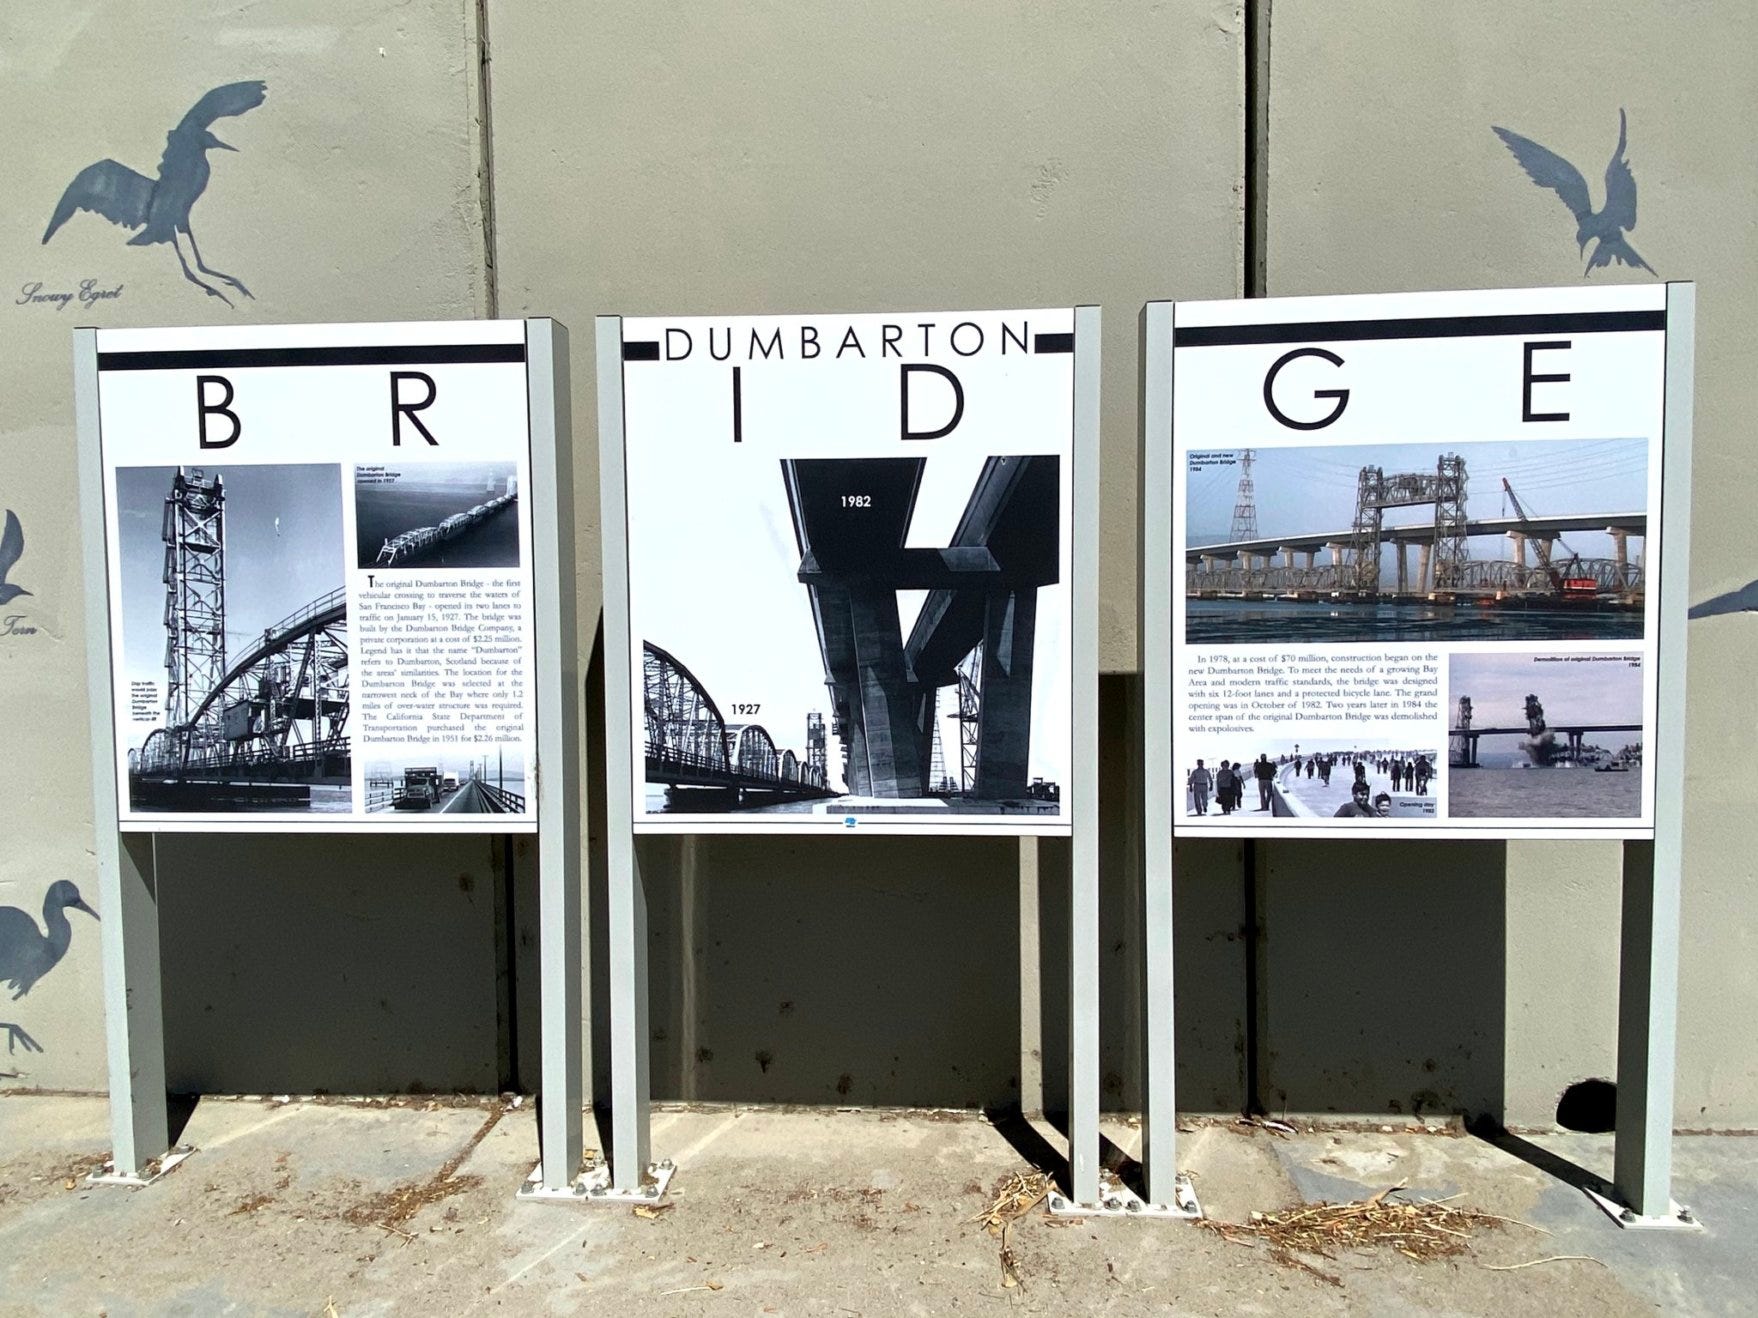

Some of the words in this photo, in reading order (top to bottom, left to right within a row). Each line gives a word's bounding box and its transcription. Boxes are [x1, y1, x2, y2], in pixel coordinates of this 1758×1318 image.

[16, 282, 74, 311] Snowy
[79, 279, 124, 309] Egret
[666, 321, 1028, 361] DUMBARTON
[1263, 347, 1350, 430] G
[1522, 341, 1572, 422] E
[732, 366, 742, 442] I
[900, 364, 964, 440] D
[196, 376, 241, 450] B
[390, 372, 438, 447] R
[841, 495, 871, 508] 1982
[368, 575, 383, 588] The
[385, 579, 412, 589] original
[415, 579, 457, 587] Dumbarton
[460, 579, 483, 589] Bridge
[492, 579, 503, 587] the
[506, 579, 520, 587] first
[358, 591, 390, 599] vehicular
[394, 591, 423, 600] crossing
[438, 590, 466, 598] traverse
[469, 590, 480, 598] the
[485, 590, 507, 598] waters
[359, 613, 380, 621] traffic
[397, 613, 423, 623] January
[465, 613, 478, 621] The
[481, 613, 504, 622] bridge
[359, 624, 375, 632] built
[379, 624, 387, 634] by
[390, 624, 401, 632] the
[405, 624, 448, 632] Dumbarton
[451, 624, 474, 633] Bridge
[359, 635, 383, 645] private
[386, 635, 428, 645] corporation
[444, 635, 459, 643] cost
[473, 635, 492, 643] $2.25
[1197, 655, 1206, 663] In
[1232, 655, 1239, 663] at
[1249, 655, 1265, 663] cost
[1268, 654, 1278, 662] of
[1281, 654, 1295, 662] $70
[1330, 654, 1381, 662] construction
[1384, 654, 1408, 664] began
[1424, 654, 1438, 662] the
[1207, 666, 1253, 674] Dumbarton
[1287, 666, 1299, 674] To
[1301, 666, 1321, 674] meet
[1324, 666, 1336, 674] the
[1340, 666, 1363, 674] needs
[1365, 666, 1376, 674] of
[1386, 665, 1420, 675] growing
[1422, 665, 1438, 675] Bay
[1188, 678, 1207, 686] Area
[1211, 678, 1225, 686] and
[1229, 678, 1260, 686] modern
[1264, 678, 1288, 686] traffic
[1336, 678, 1349, 686] the
[1353, 678, 1378, 688] bridge
[1402, 677, 1437, 687] designed
[1187, 690, 1205, 698] with
[1208, 690, 1219, 698] six
[1223, 690, 1251, 698] 12-foot
[1254, 690, 1274, 698] lanes
[1277, 689, 1291, 697] and
[1302, 689, 1340, 699] protected
[1343, 689, 1370, 699] bicycle
[1396, 689, 1411, 697] The
[1414, 689, 1437, 699] grand
[731, 704, 760, 715] 1927
[1188, 701, 1220, 711] opening
[1240, 701, 1248, 709] in
[1251, 701, 1284, 709] October
[1287, 701, 1297, 709] of
[1326, 701, 1343, 709] Two
[1370, 701, 1387, 709] later
[1390, 700, 1398, 708] in
[1402, 700, 1421, 708] 1984
[1424, 700, 1437, 708] the
[362, 712, 376, 720] The
[386, 712, 422, 720] California
[432, 712, 449, 720] State
[460, 712, 504, 722] Department
[1188, 713, 1212, 721] center
[1236, 713, 1245, 721] of
[1248, 713, 1260, 721] the
[1262, 713, 1292, 723] original
[1295, 713, 1342, 721] Dumbarton
[1345, 713, 1370, 723] Bridge
[1390, 712, 1437, 720] demolished
[1188, 724, 1205, 732] with
[363, 734, 404, 742] Dumbarton
[406, 734, 430, 744] Bridge
[442, 734, 457, 742] 1951
[460, 734, 471, 742] for
[473, 734, 493, 742] $2.26
